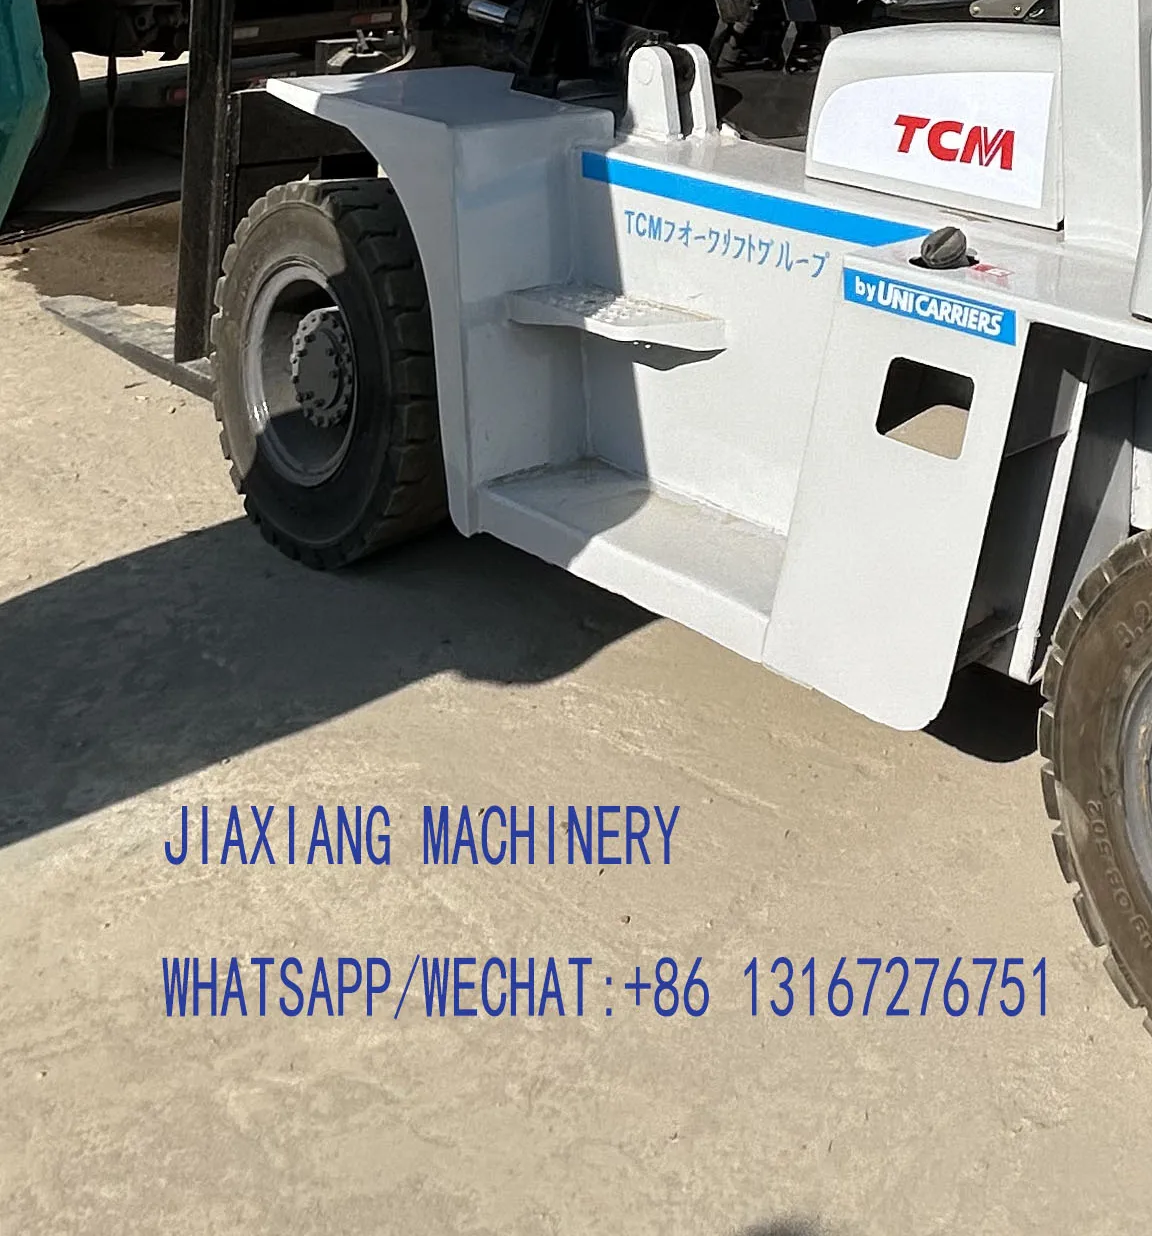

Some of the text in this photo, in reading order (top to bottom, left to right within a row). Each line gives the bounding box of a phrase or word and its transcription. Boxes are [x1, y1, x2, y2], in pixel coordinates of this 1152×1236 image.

[893, 114, 1016, 171] TCM
[855, 275, 1005, 337] by UNICARRIERS
